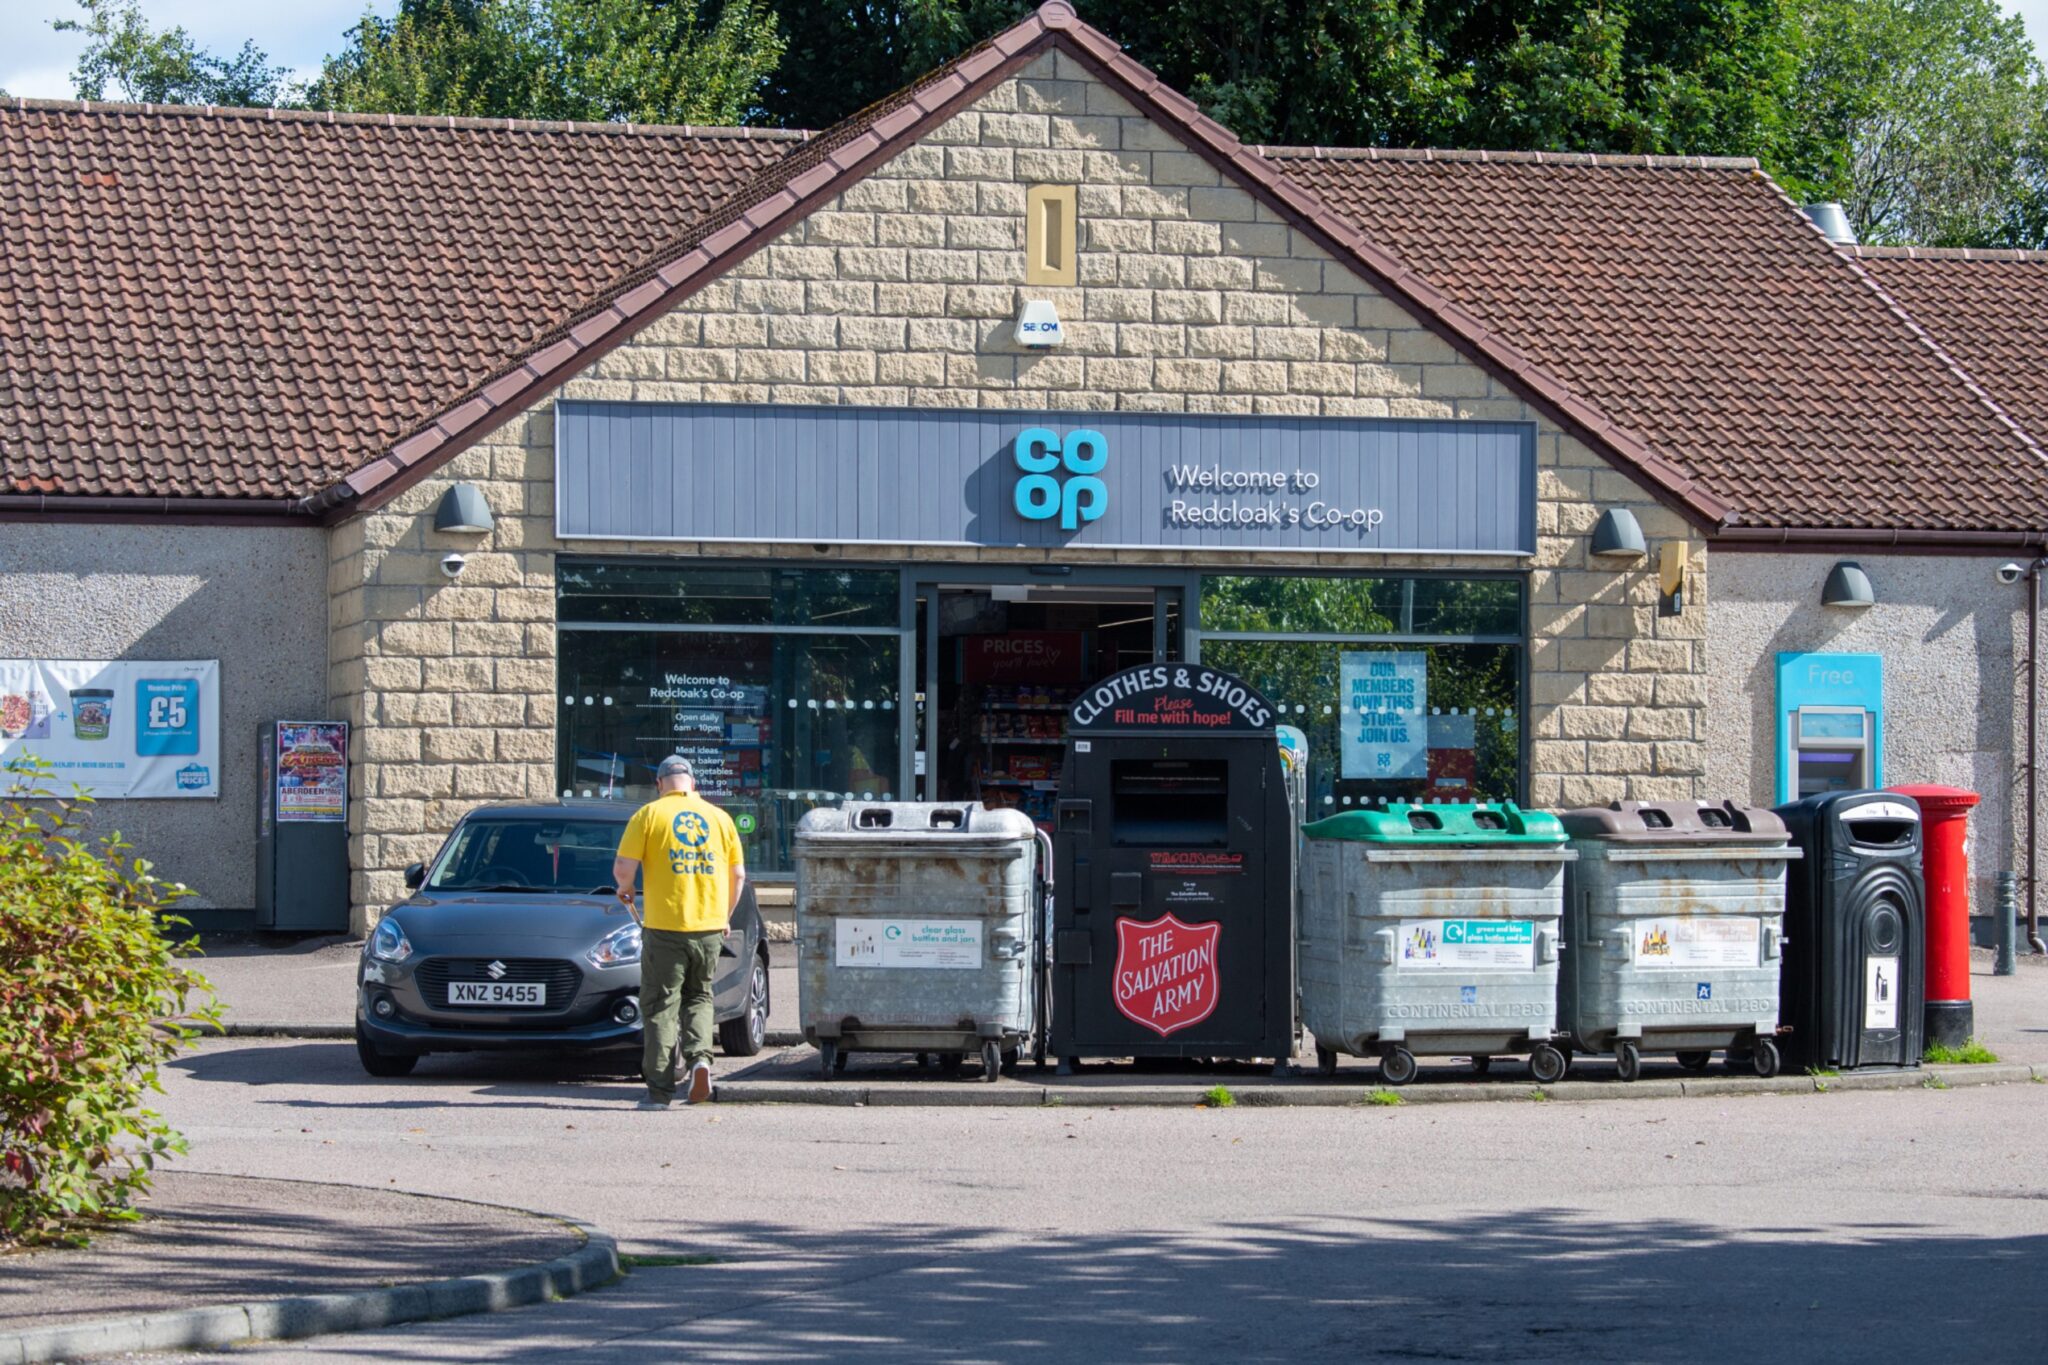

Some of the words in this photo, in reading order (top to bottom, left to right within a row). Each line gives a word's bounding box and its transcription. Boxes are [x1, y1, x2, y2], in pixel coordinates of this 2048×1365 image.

[1023, 322, 1057, 332] SEOM
[1172, 464, 1286, 487] Welcome
[1294, 468, 1319, 487] to
[1171, 499, 1299, 523] Redcloak's
[1308, 501, 1383, 532] Co-op
[983, 639, 1044, 654] PRICES
[1370, 662, 1396, 677] OUR
[1808, 665, 1855, 685] Free
[665, 673, 716, 685] Welcome
[719, 675, 730, 685] to
[1352, 678, 1414, 693] MEMBERS
[650, 687, 708, 698] Redcloak's
[711, 688, 745, 701] Co-op
[1073, 666, 1168, 725] CLOTHES
[1173, 668, 1191, 689] &
[1196, 672, 1271, 727] SHOES
[1154, 695, 1194, 711] Please
[1353, 695, 1382, 709] OWN
[1384, 695, 1414, 709] THIS
[149, 696, 187, 728] £5
[675, 713, 699, 722] Open
[700, 713, 719, 722] daily
[1115, 709, 1134, 723] Fill
[1137, 713, 1158, 724] me
[1161, 711, 1190, 724] with
[1193, 711, 1231, 727] hope!
[699, 725, 721, 733] 10pm
[1357, 728, 1388, 743] JOIN
[1390, 728, 1410, 743] US.
[675, 746, 695, 754] Meal
[697, 746, 719, 754] ideas
[697, 757, 725, 766] bakery
[716, 779, 727, 788] go
[281, 787, 325, 795] ABERDEEN
[701, 788, 732, 796] ssentials
[669, 848, 714, 861] Marie
[671, 862, 714, 875] Curie
[921, 925, 942, 934] clear
[944, 925, 966, 935] glass
[912, 933, 940, 942] bottles
[941, 934, 958, 942] and
[959, 935, 976, 943] jars
[1139, 929, 1174, 961] THE
[1120, 939, 1210, 1000] SALVATION
[455, 984, 488, 1001] XNZ
[493, 985, 537, 1002] 9455
[1152, 973, 1205, 1018] ARMY
[1387, 1003, 1500, 1018] CONTINENTAL
[1506, 1003, 1545, 1016] 1280
[1625, 1000, 1729, 1014] CONTINENTAL
[1735, 1000, 1770, 1012] 1280
